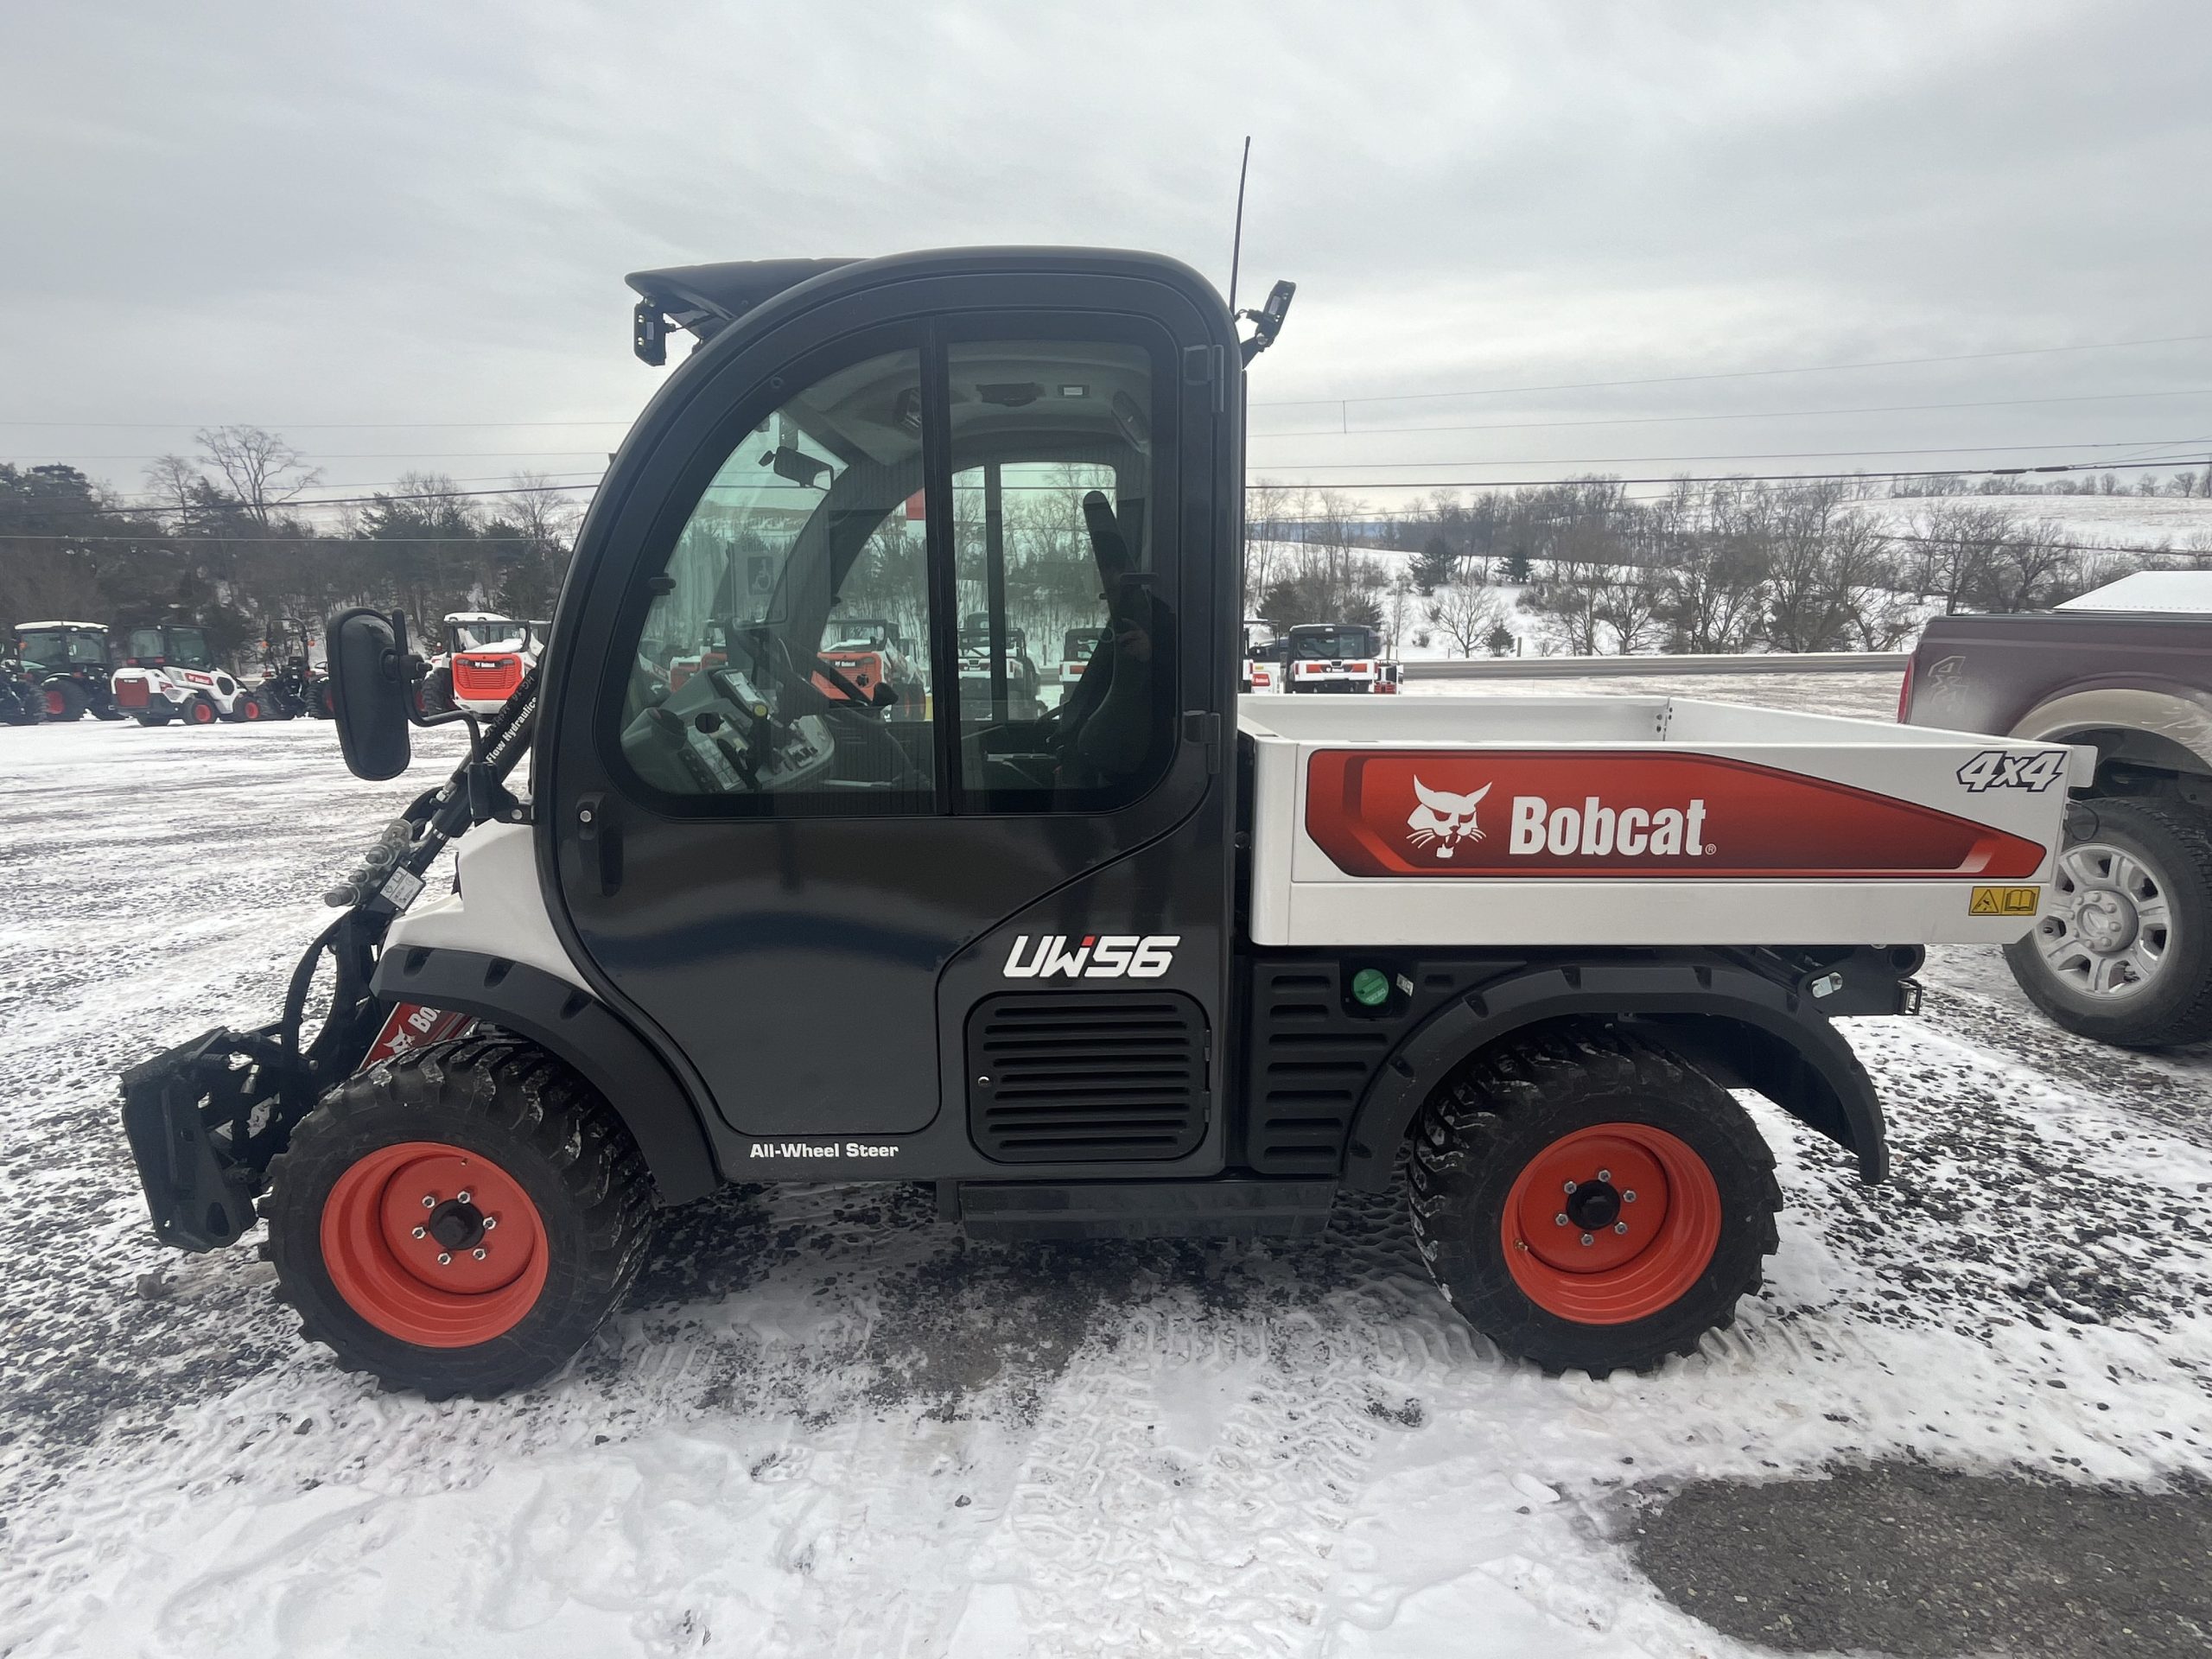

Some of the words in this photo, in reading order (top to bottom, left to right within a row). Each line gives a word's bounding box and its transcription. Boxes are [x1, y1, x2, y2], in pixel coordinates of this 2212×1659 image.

[485, 741, 506, 764] Flow
[1956, 751, 2067, 792] 4x4
[1510, 796, 1707, 855] Bobcat
[408, 1006, 441, 1033] Bo
[749, 1143, 840, 1158] All-Wheel
[846, 1142, 899, 1157] Steer
